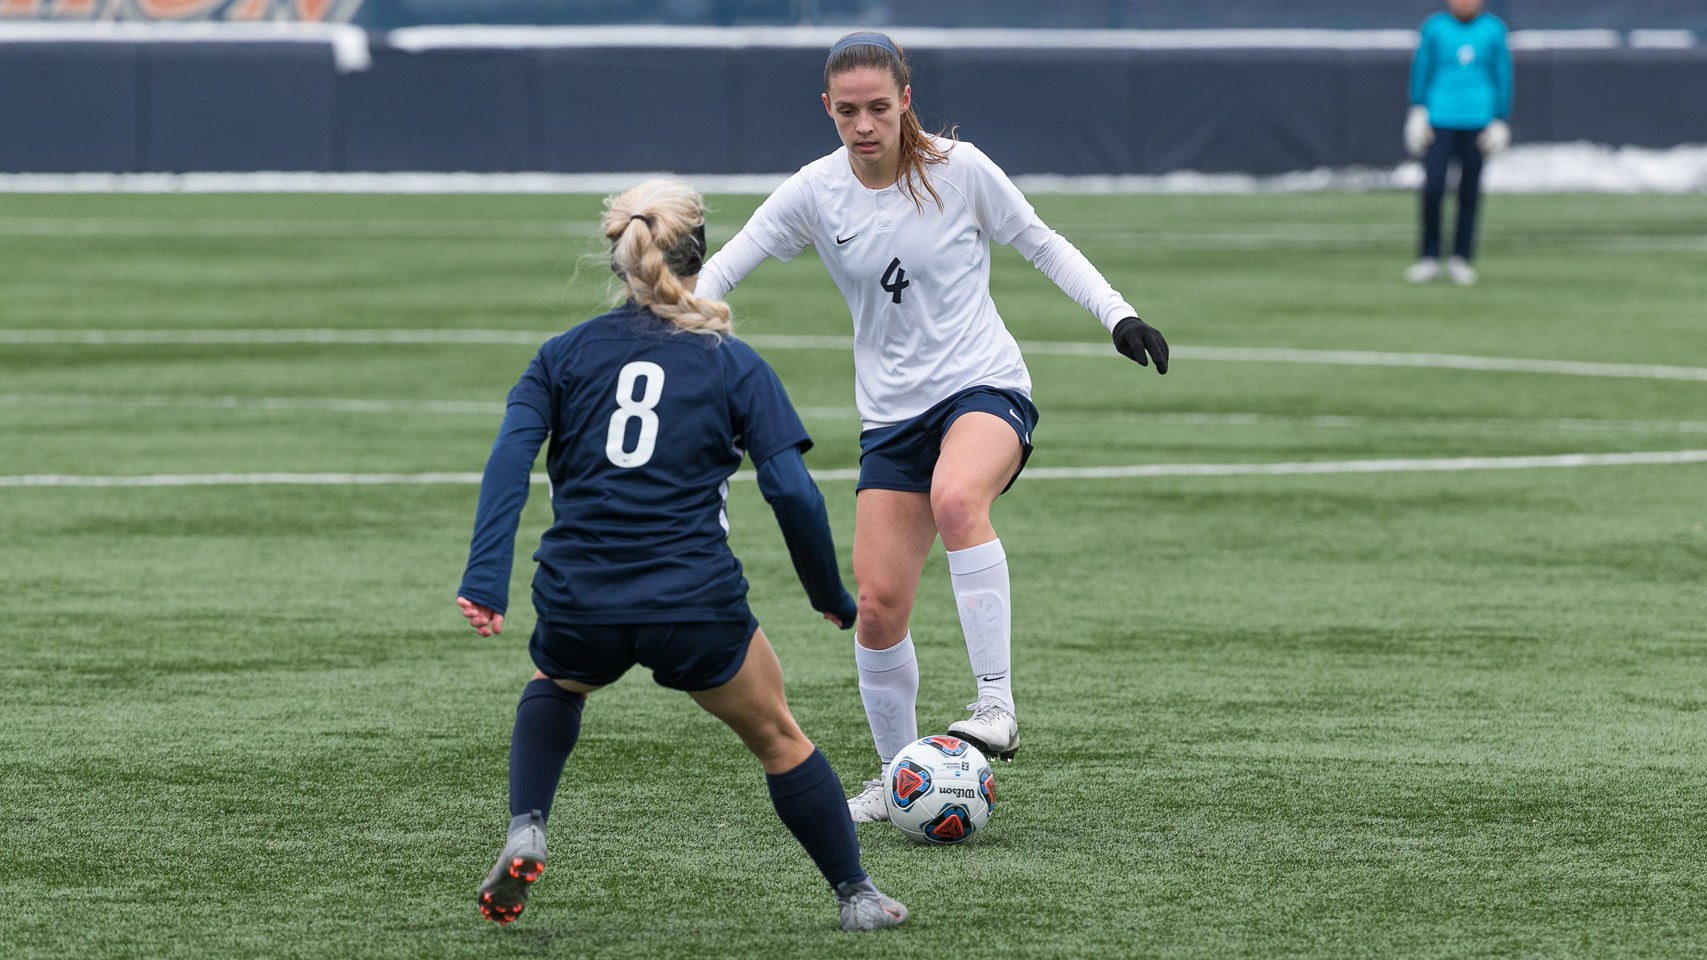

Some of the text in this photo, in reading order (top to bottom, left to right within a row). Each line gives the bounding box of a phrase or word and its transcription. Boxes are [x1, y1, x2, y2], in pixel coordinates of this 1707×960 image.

[880, 257, 909, 304] 4
[605, 361, 665, 468] 8
[939, 787, 975, 799] Wilson
